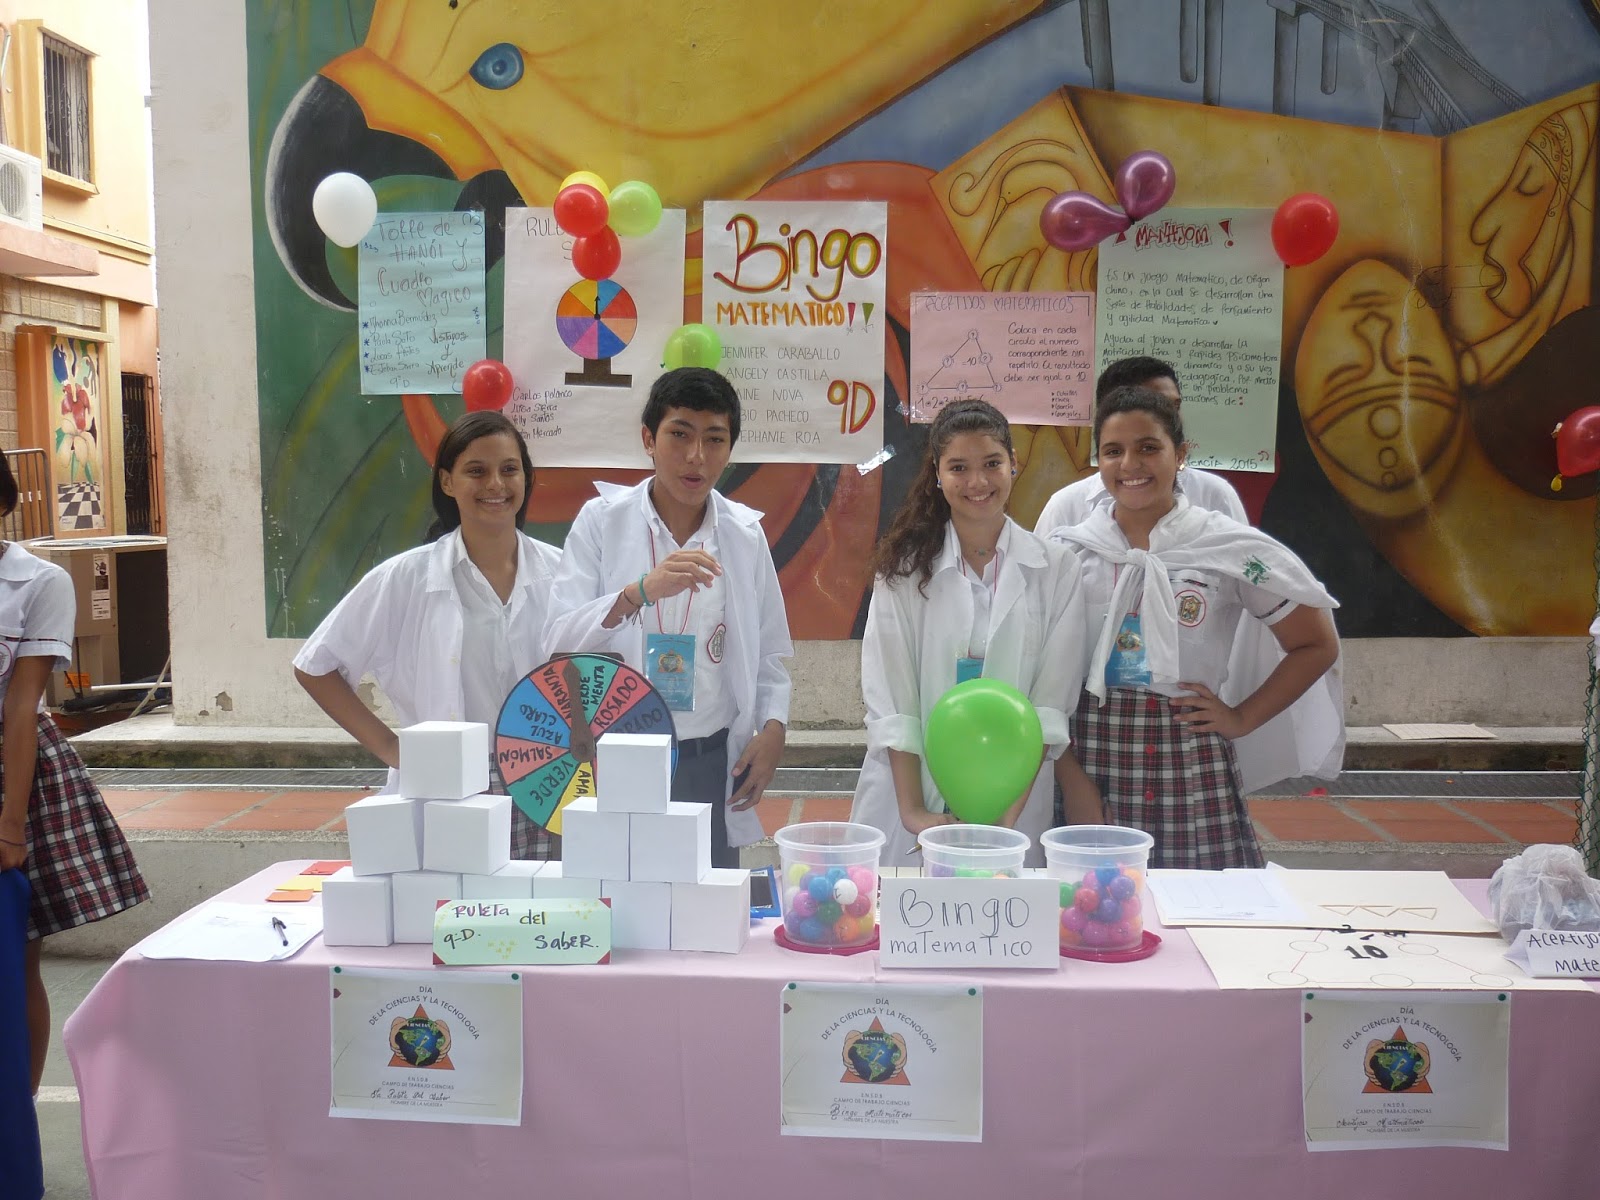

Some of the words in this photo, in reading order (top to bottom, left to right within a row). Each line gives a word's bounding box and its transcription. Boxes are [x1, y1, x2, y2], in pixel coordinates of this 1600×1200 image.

[434, 217, 452, 236] de
[713, 213, 881, 302] Bingo
[1230, 275, 1242, 285] de
[1140, 289, 1149, 297] en
[1152, 288, 1161, 297] la
[994, 295, 1074, 313] MATEMATICOS
[1131, 300, 1141, 310] de
[1201, 302, 1214, 314] de
[1119, 314, 1154, 327] agilidad
[1008, 322, 1037, 334] Coloca
[1057, 326, 1077, 334] cada
[1137, 334, 1146, 344] al
[1192, 338, 1233, 350] desarrollar
[721, 347, 768, 359] JENNIFER
[777, 347, 840, 361] CARABALLO
[1055, 360, 1091, 370] resultado
[1227, 364, 1234, 374] y
[726, 368, 769, 380] ANGELY
[777, 368, 830, 381] CASTILLA
[1003, 373, 1022, 382] debe
[1044, 372, 1062, 384] igual
[1076, 371, 1087, 382] 10
[736, 388, 760, 401] AINE
[772, 388, 804, 401] NOVA
[1207, 384, 1248, 395] problema
[740, 409, 757, 421] BIO
[766, 410, 809, 423] PACHECO
[740, 430, 786, 444] EPHANIE
[796, 431, 821, 445] ROA
[1230, 457, 1258, 470] 2015
[590, 664, 605, 705] MENTA
[594, 675, 638, 729] ROSADO
[520, 703, 557, 725] CLARO
[531, 725, 564, 745] AZUL
[530, 759, 574, 806] VERDE
[519, 909, 546, 925] del
[900, 888, 1030, 937] Bingo
[1344, 945, 1388, 959] 10
[369, 1015, 379, 1026] DE
[377, 1008, 386, 1017] LA
[385, 995, 421, 1010] CIENCIAS
[430, 997, 439, 1005] LA
[440, 1000, 480, 1040] TECNOLOGÍA
[821, 1029, 831, 1041] DE
[831, 1022, 841, 1032] LA
[840, 1007, 877, 1024] CIENCIAS
[886, 1008, 897, 1017] LA
[897, 1012, 938, 1053] TECNOLOGÍA
[1342, 1039, 1352, 1050] DE
[1351, 1031, 1361, 1041] LA
[1361, 1017, 1400, 1033] CIENCIAS
[1410, 1018, 1420, 1026] LA
[1422, 1021, 1462, 1062] TECNOLOGÍA
